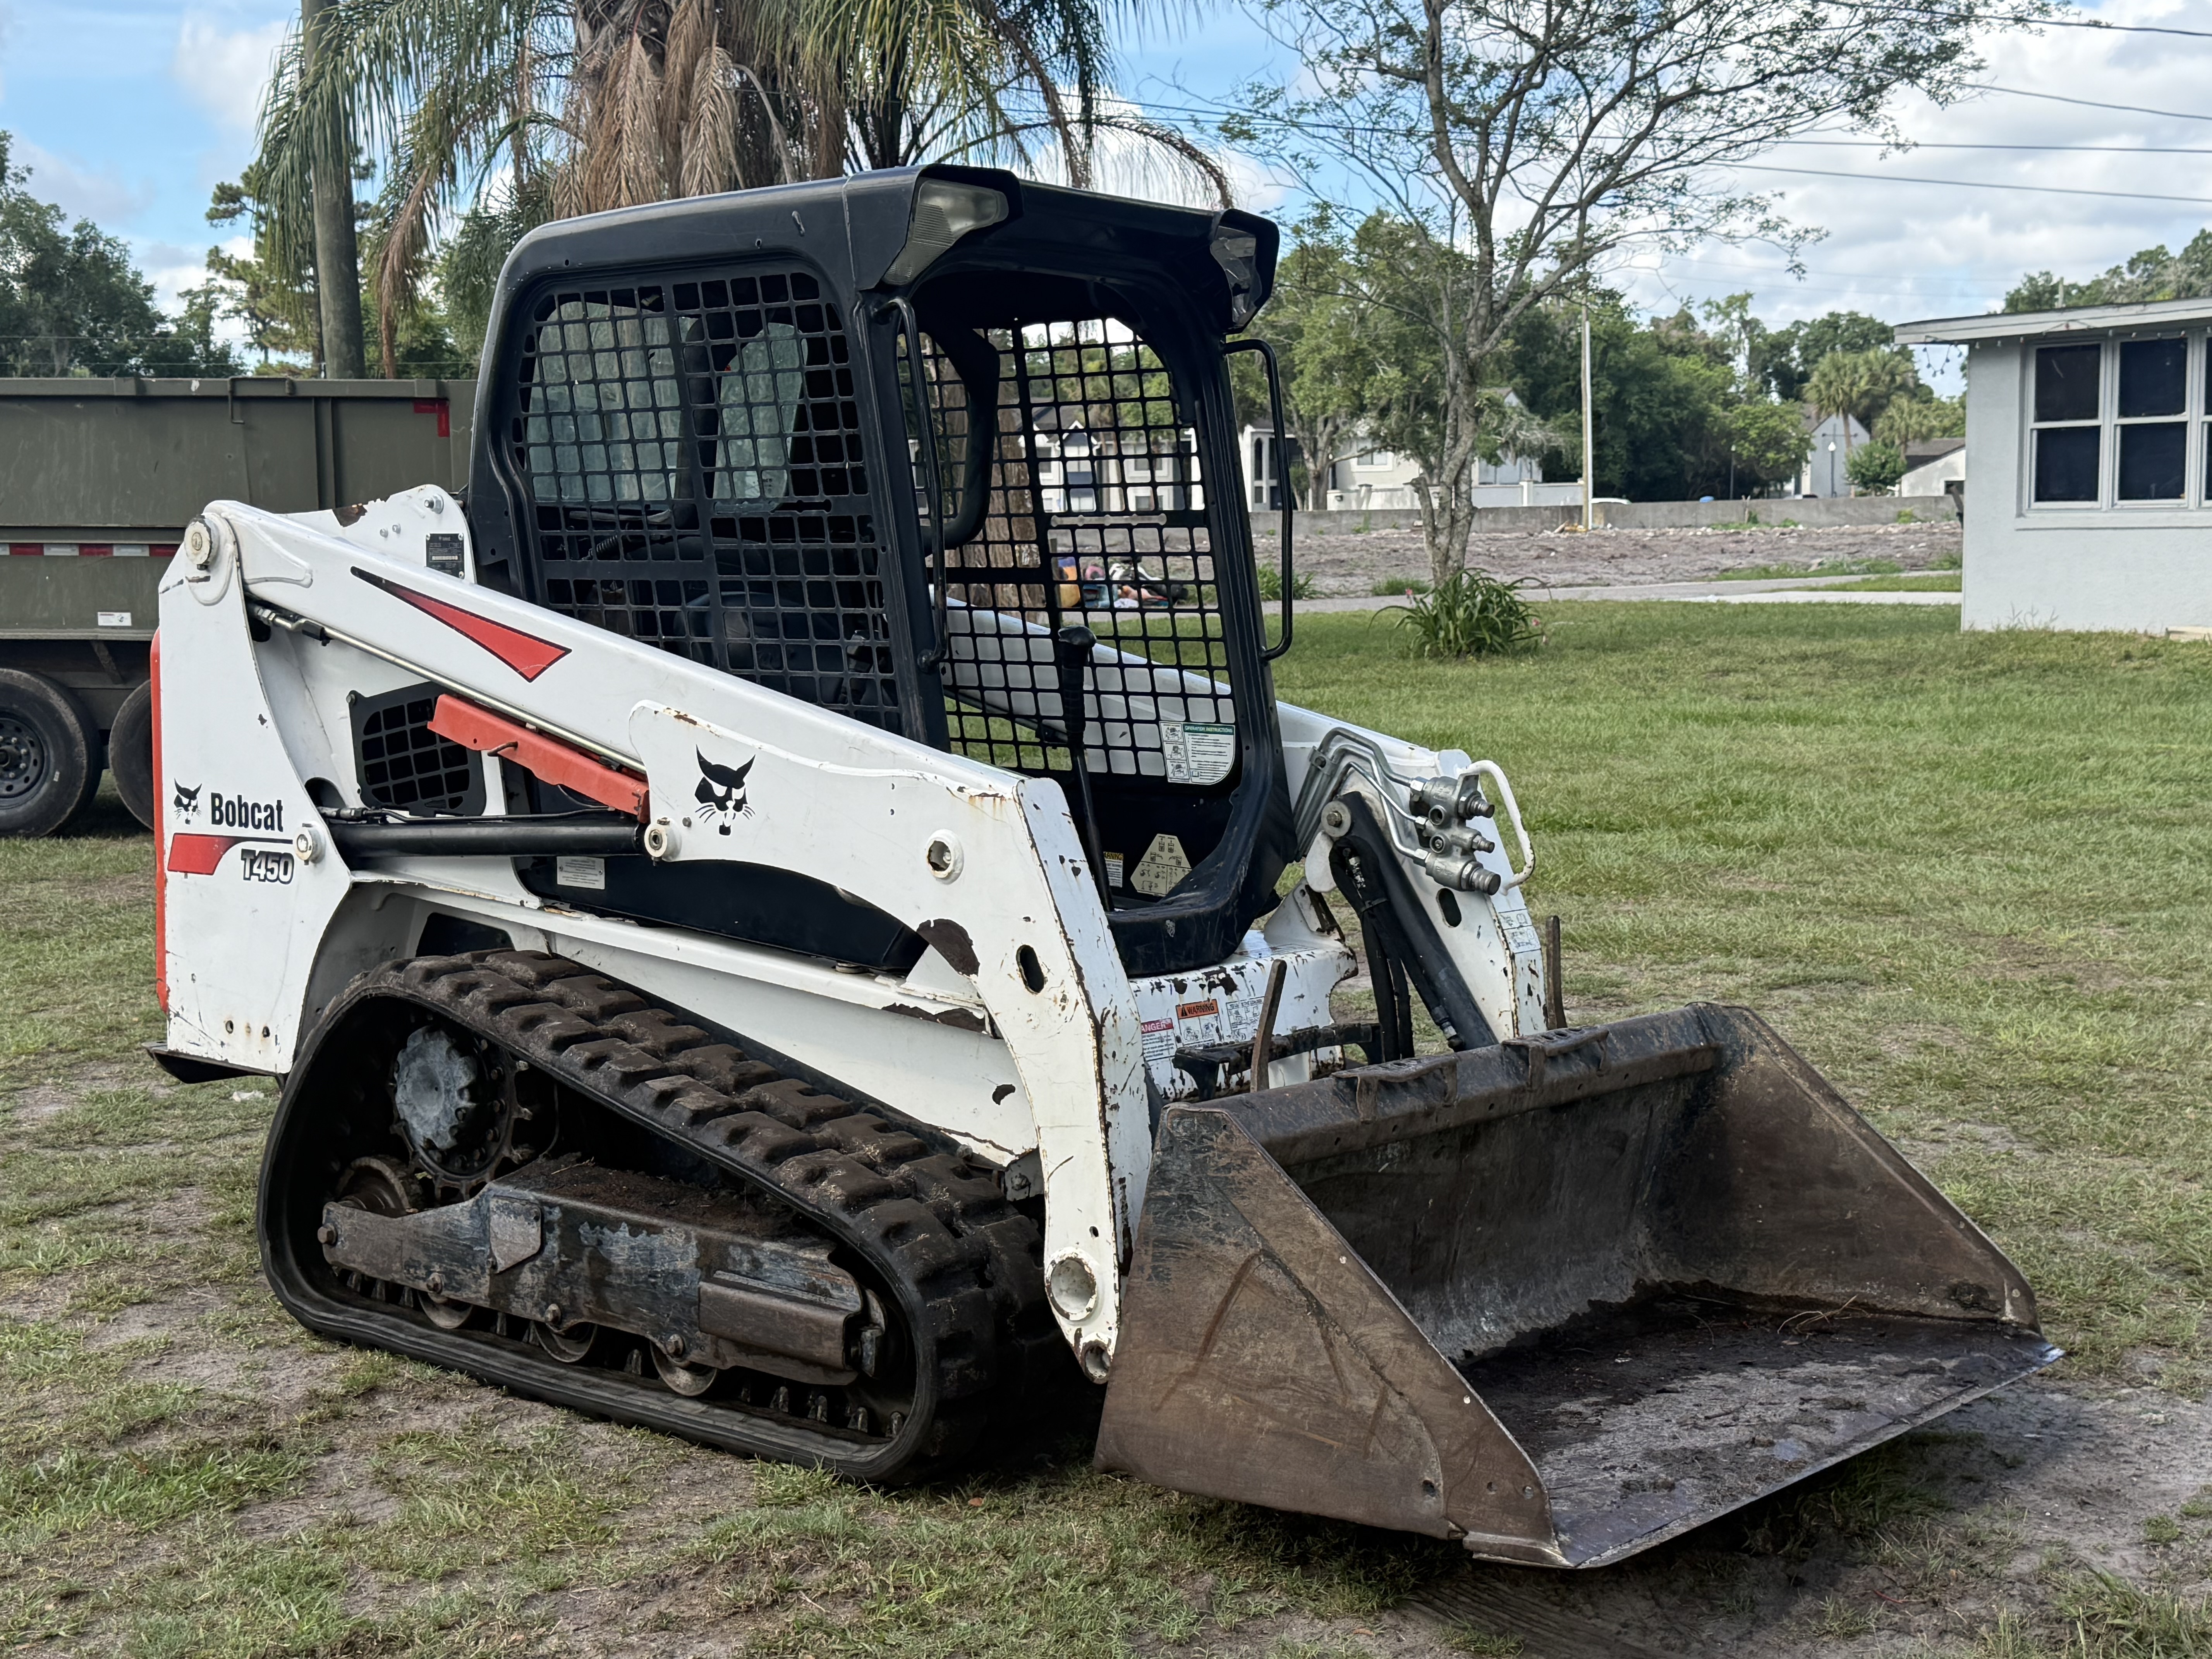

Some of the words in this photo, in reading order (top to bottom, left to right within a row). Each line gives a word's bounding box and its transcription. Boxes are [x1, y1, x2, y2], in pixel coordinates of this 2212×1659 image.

[211, 792, 283, 832] Bobcat
[241, 848, 294, 884] T450
[1187, 1003, 1214, 1015] WARNING
[1141, 1022, 1166, 1032] ANGER
